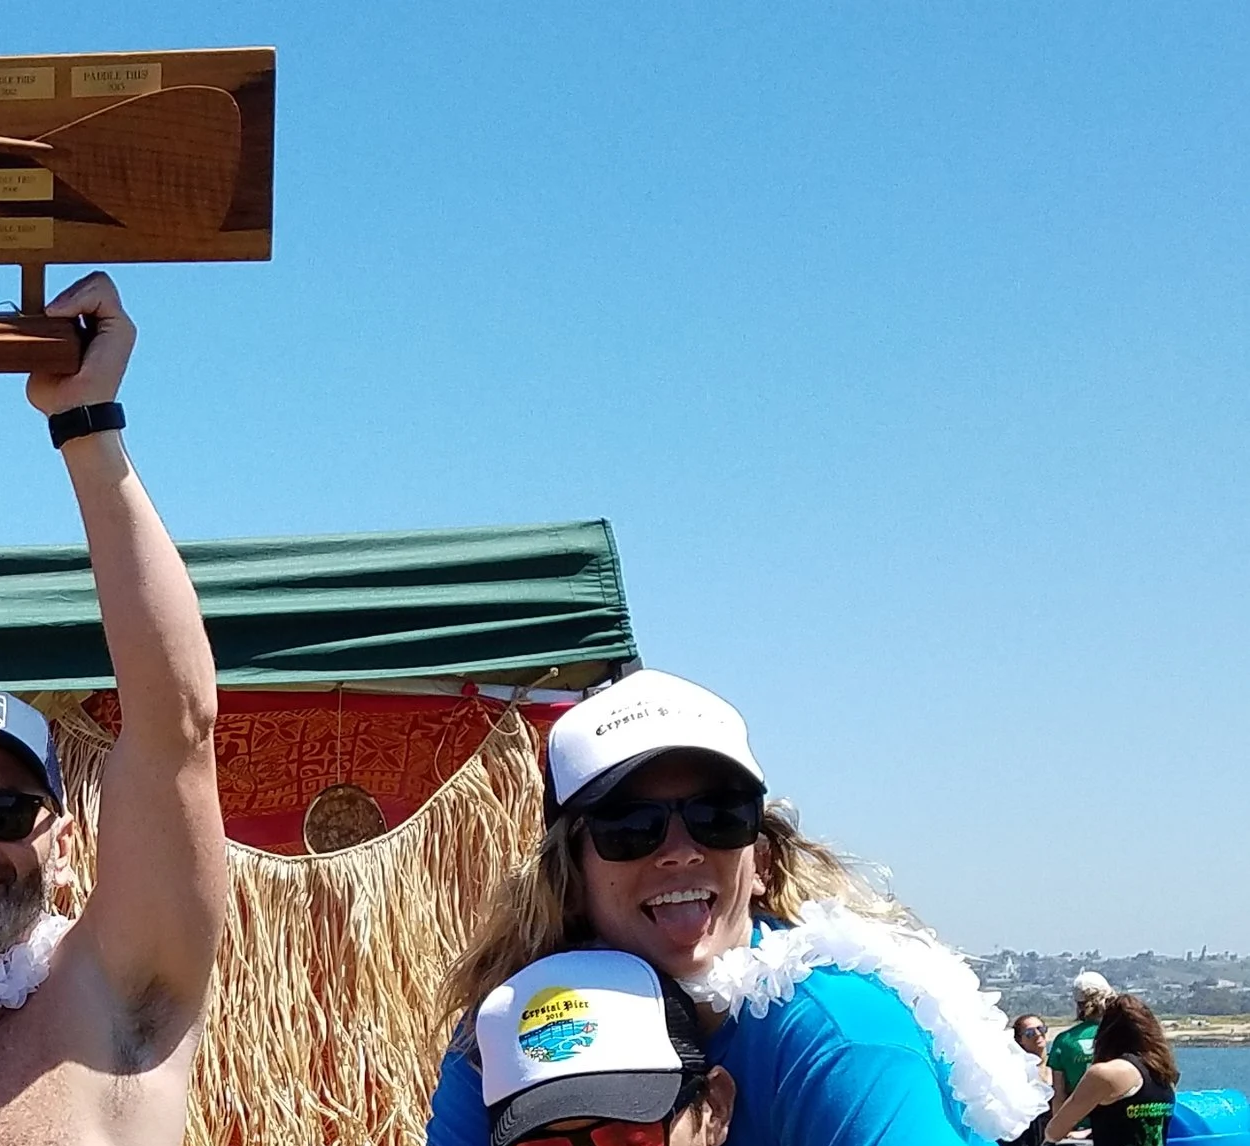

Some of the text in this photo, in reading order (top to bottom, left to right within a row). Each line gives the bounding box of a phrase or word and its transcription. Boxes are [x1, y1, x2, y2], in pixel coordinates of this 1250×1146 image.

[83, 71, 121, 81] PADDLE
[595, 709, 650, 736] Crystal
[522, 1000, 589, 1021] Crystal Pier
